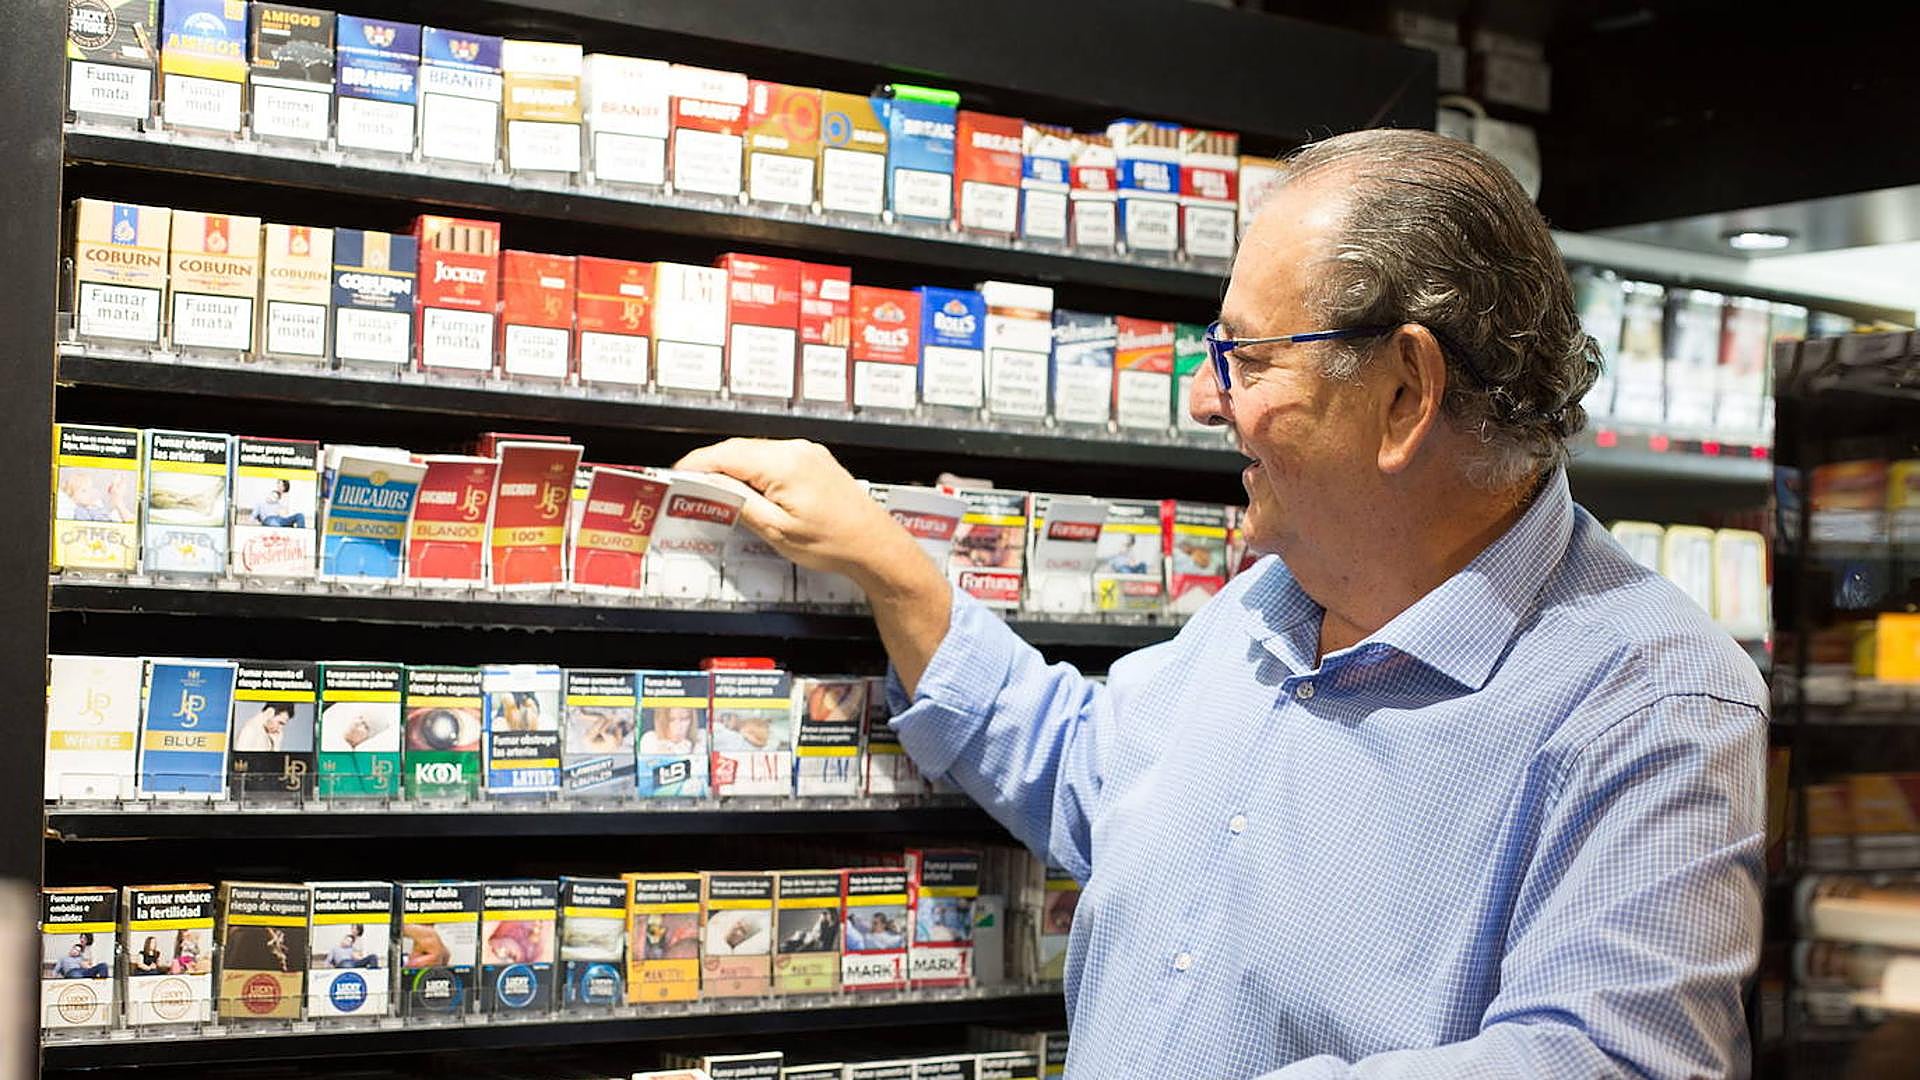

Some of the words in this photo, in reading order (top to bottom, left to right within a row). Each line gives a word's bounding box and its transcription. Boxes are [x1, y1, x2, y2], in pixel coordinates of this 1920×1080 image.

[72, 9, 107, 21] LUCKY
[262, 9, 321, 27] AMIGOS
[71, 19, 107, 34] STRIKE
[168, 33, 241, 55] AMIGOS
[86, 66, 136, 84] Fumar
[429, 70, 495, 90] BRANIFF
[91, 86, 129, 102] mata
[86, 249, 161, 267] COBURN
[179, 259, 253, 276] COBURN
[270, 267, 328, 281] COBURN
[338, 273, 412, 296] COBURN
[92, 288, 148, 306] Fumar
[97, 307, 140, 322] mata
[186, 299, 240, 316] Fumar
[191, 316, 233, 331] mata
[272, 309, 320, 325] Fumar
[348, 313, 398, 331] Fumar
[278, 325, 316, 340] mata
[431, 315, 486, 335] Fumar
[353, 330, 392, 345] mata
[436, 334, 480, 350] mata
[154, 436, 183, 449] Fumar
[185, 438, 225, 453] obstruye
[241, 443, 264, 454] Fumar
[265, 446, 295, 457] provoca
[154, 450, 167, 460] las
[169, 451, 205, 462] arterias
[338, 484, 409, 509] DUCADOS
[671, 498, 731, 518] Fortuna
[333, 521, 398, 536] BLANDO
[416, 524, 479, 537] BLANDO
[589, 534, 634, 548] DURO
[963, 574, 1020, 592] Fortuna
[239, 668, 262, 678] Fumar
[172, 688, 207, 728] JPS
[163, 735, 208, 748] BLUE
[279, 754, 306, 790] JPS
[137, 892, 173, 905] Fumar
[174, 891, 211, 904] reduce
[231, 888, 260, 900] Fumar
[260, 891, 299, 901] aumenta
[300, 891, 308, 900] el
[315, 890, 339, 900] Fumar
[341, 891, 370, 901] provoca
[406, 888, 432, 898] Fumar
[485, 887, 509, 896] Fumar
[50, 894, 73, 903] Fumar
[74, 895, 104, 905] provoca
[419, 901, 464, 912] pulmones
[50, 905, 84, 913] embolias
[137, 906, 148, 919] la
[150, 905, 200, 919] fertilidad
[230, 901, 257, 913] riesgo
[259, 902, 271, 911] de
[272, 904, 305, 914] ceguera
[50, 913, 83, 923] invalidez
[847, 964, 891, 978] MARK
[892, 957, 900, 979] 1
[913, 959, 958, 971] MARK
[958, 951, 968, 975] 1
